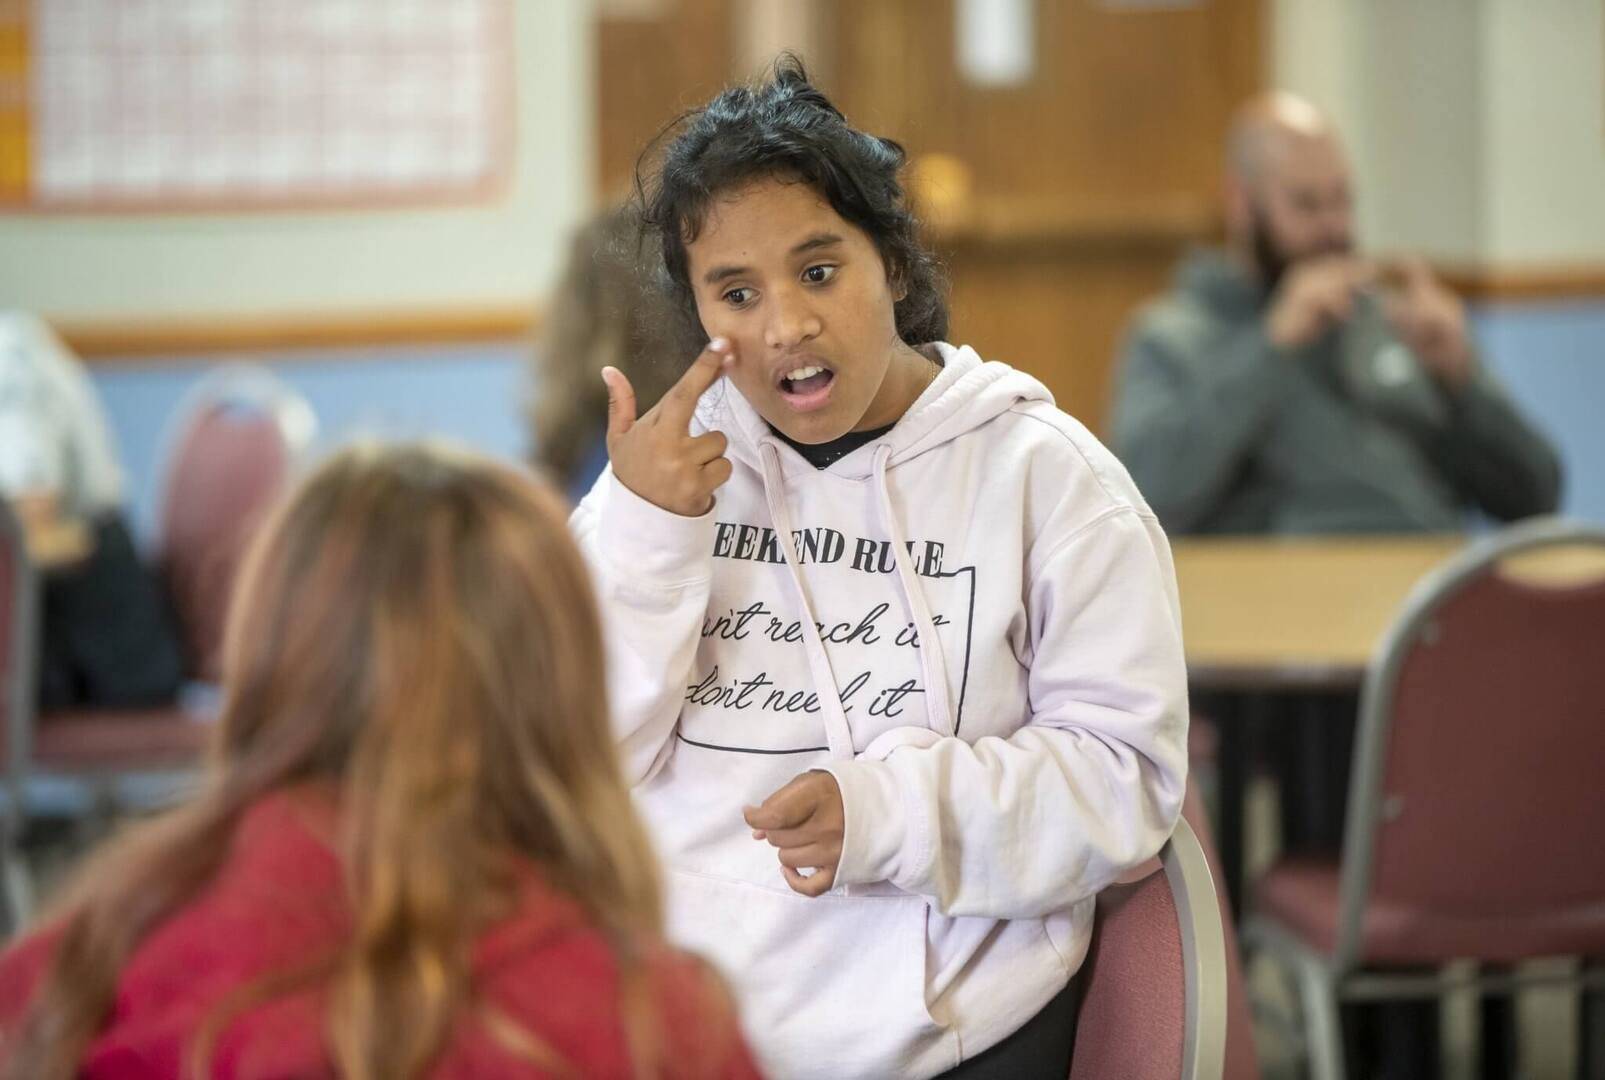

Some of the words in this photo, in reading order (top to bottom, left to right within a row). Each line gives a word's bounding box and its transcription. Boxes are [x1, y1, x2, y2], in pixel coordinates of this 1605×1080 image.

[712, 522, 845, 565] EEKND
[701, 602, 771, 641] n't
[868, 679, 926, 718] it
